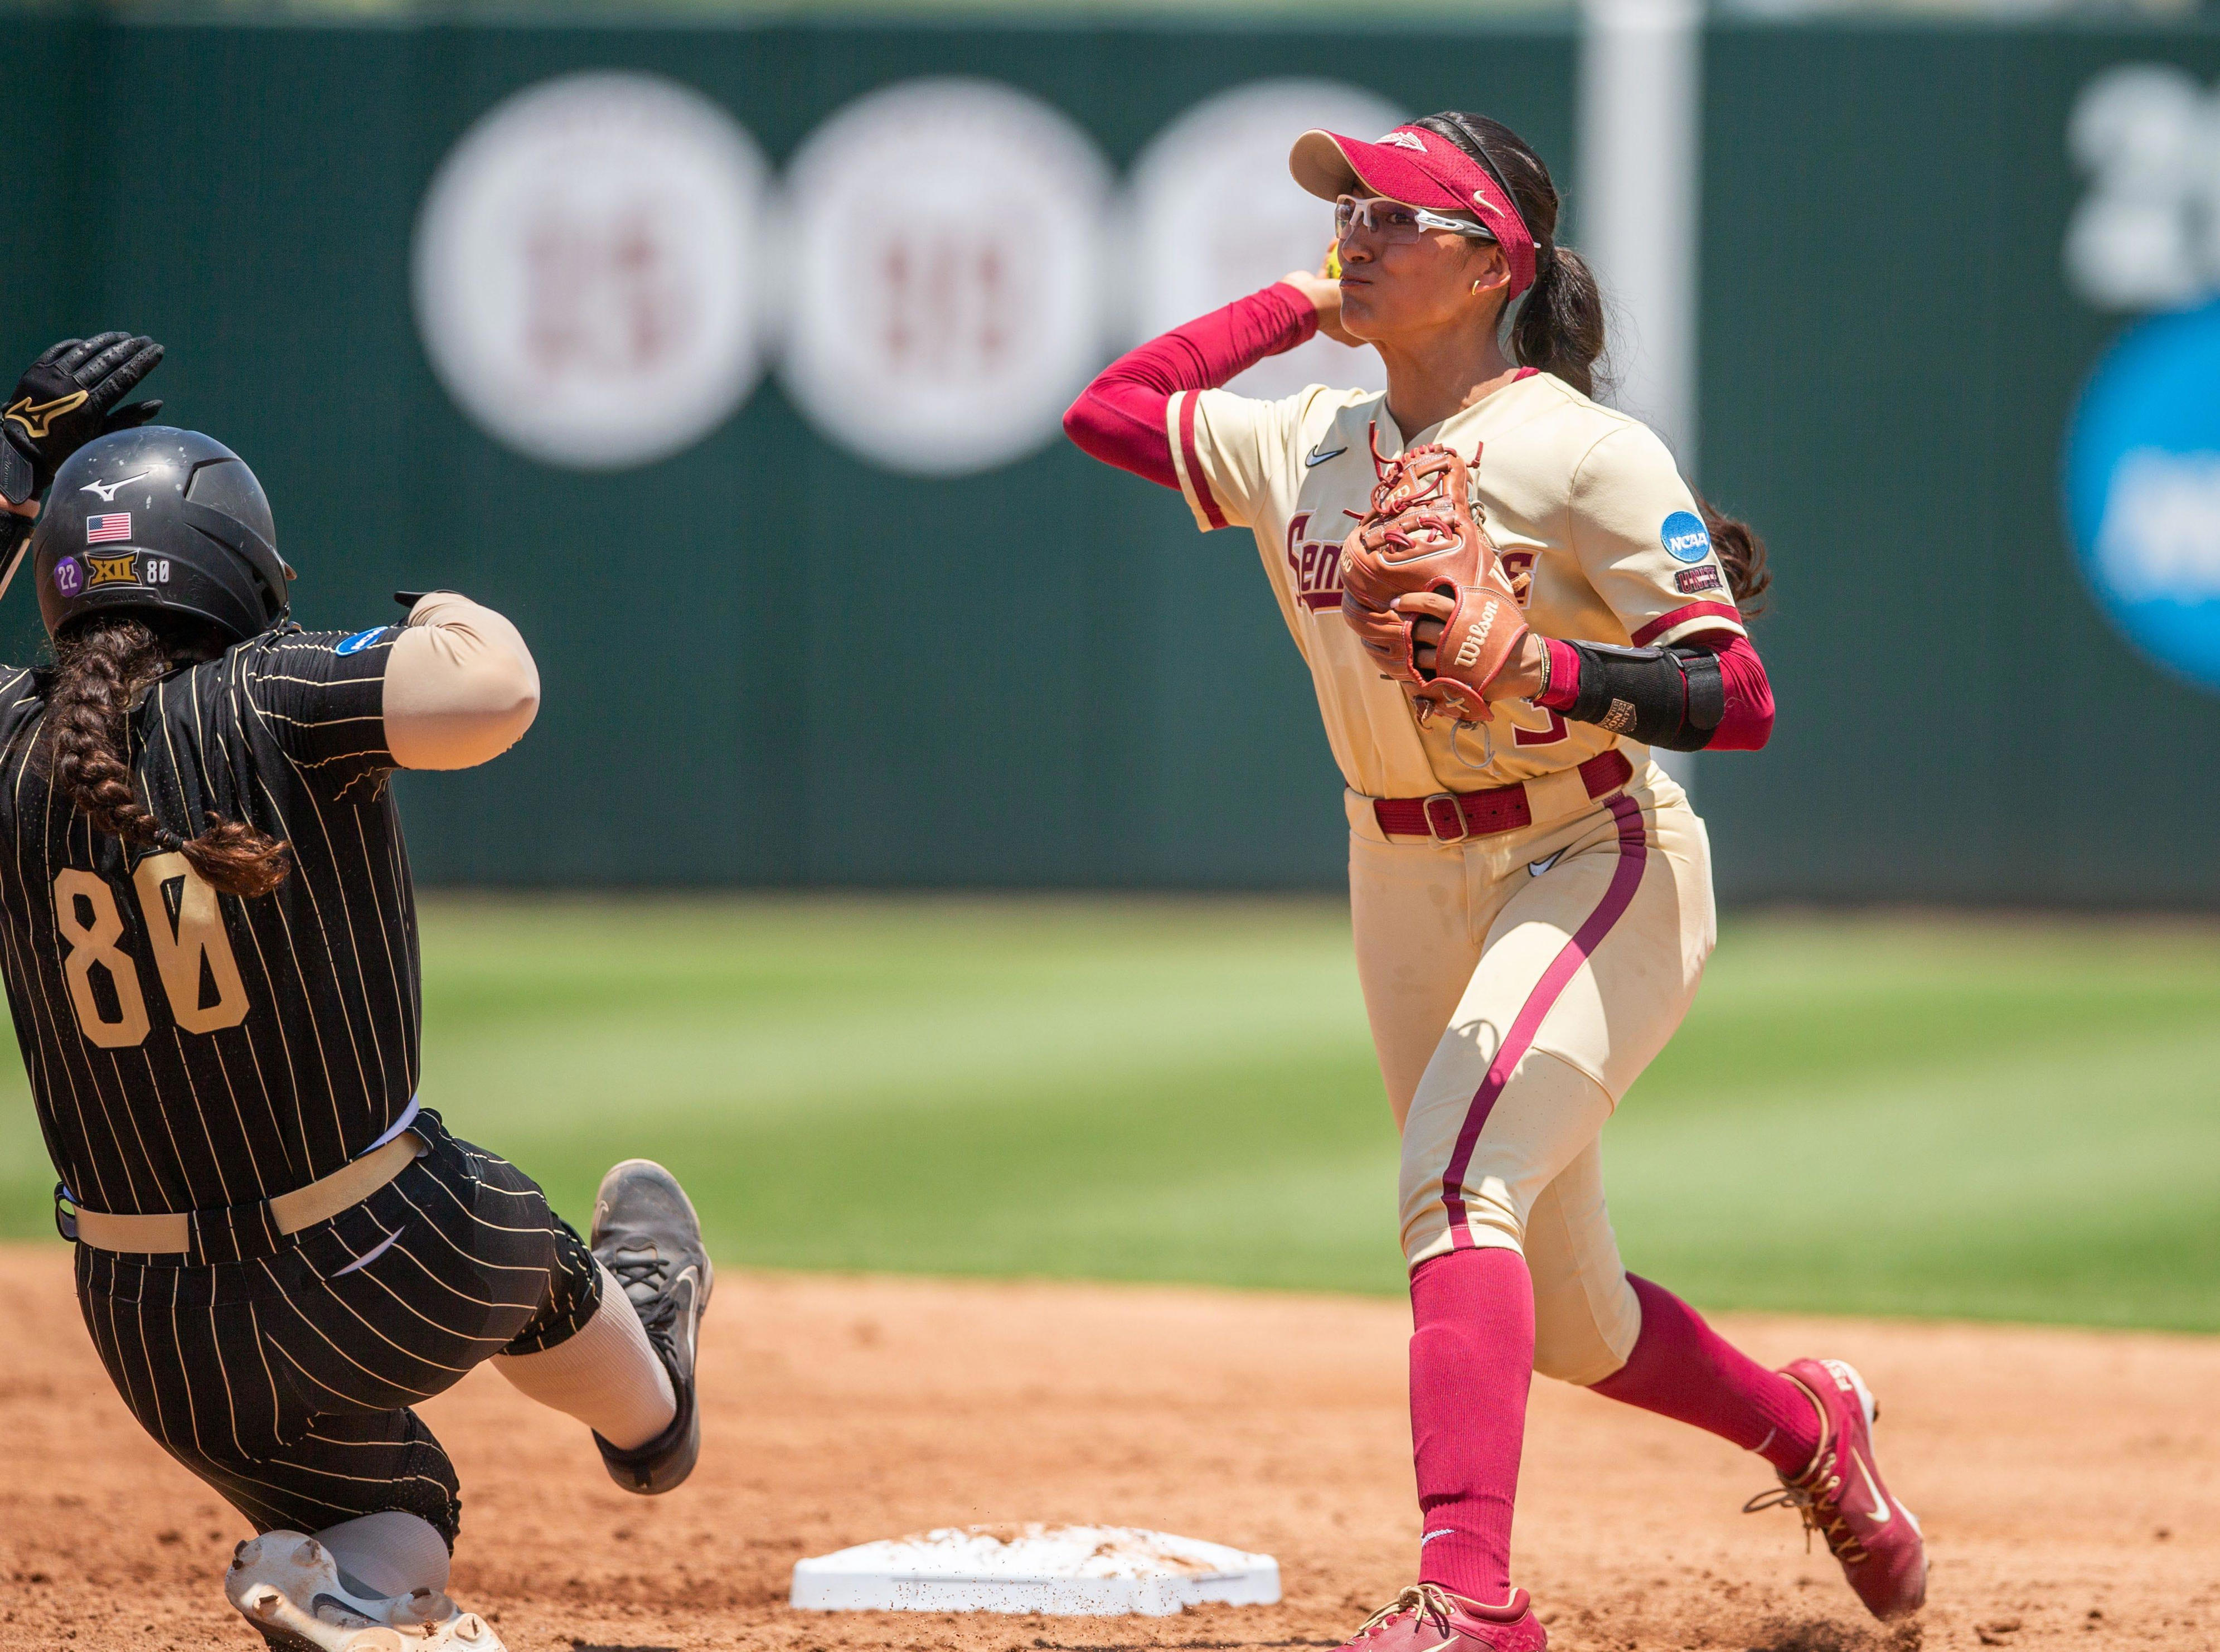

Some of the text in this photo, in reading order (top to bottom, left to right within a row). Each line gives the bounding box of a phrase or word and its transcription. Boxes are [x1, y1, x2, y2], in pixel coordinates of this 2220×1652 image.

[1669, 532, 1708, 551] NCAA
[58, 564, 77, 590] 22
[90, 555, 138, 585] XII
[147, 560, 169, 583] 80
[1678, 566, 1722, 593] UNITE
[1454, 599, 1500, 667] Wilson
[54, 850, 251, 1048] 80
